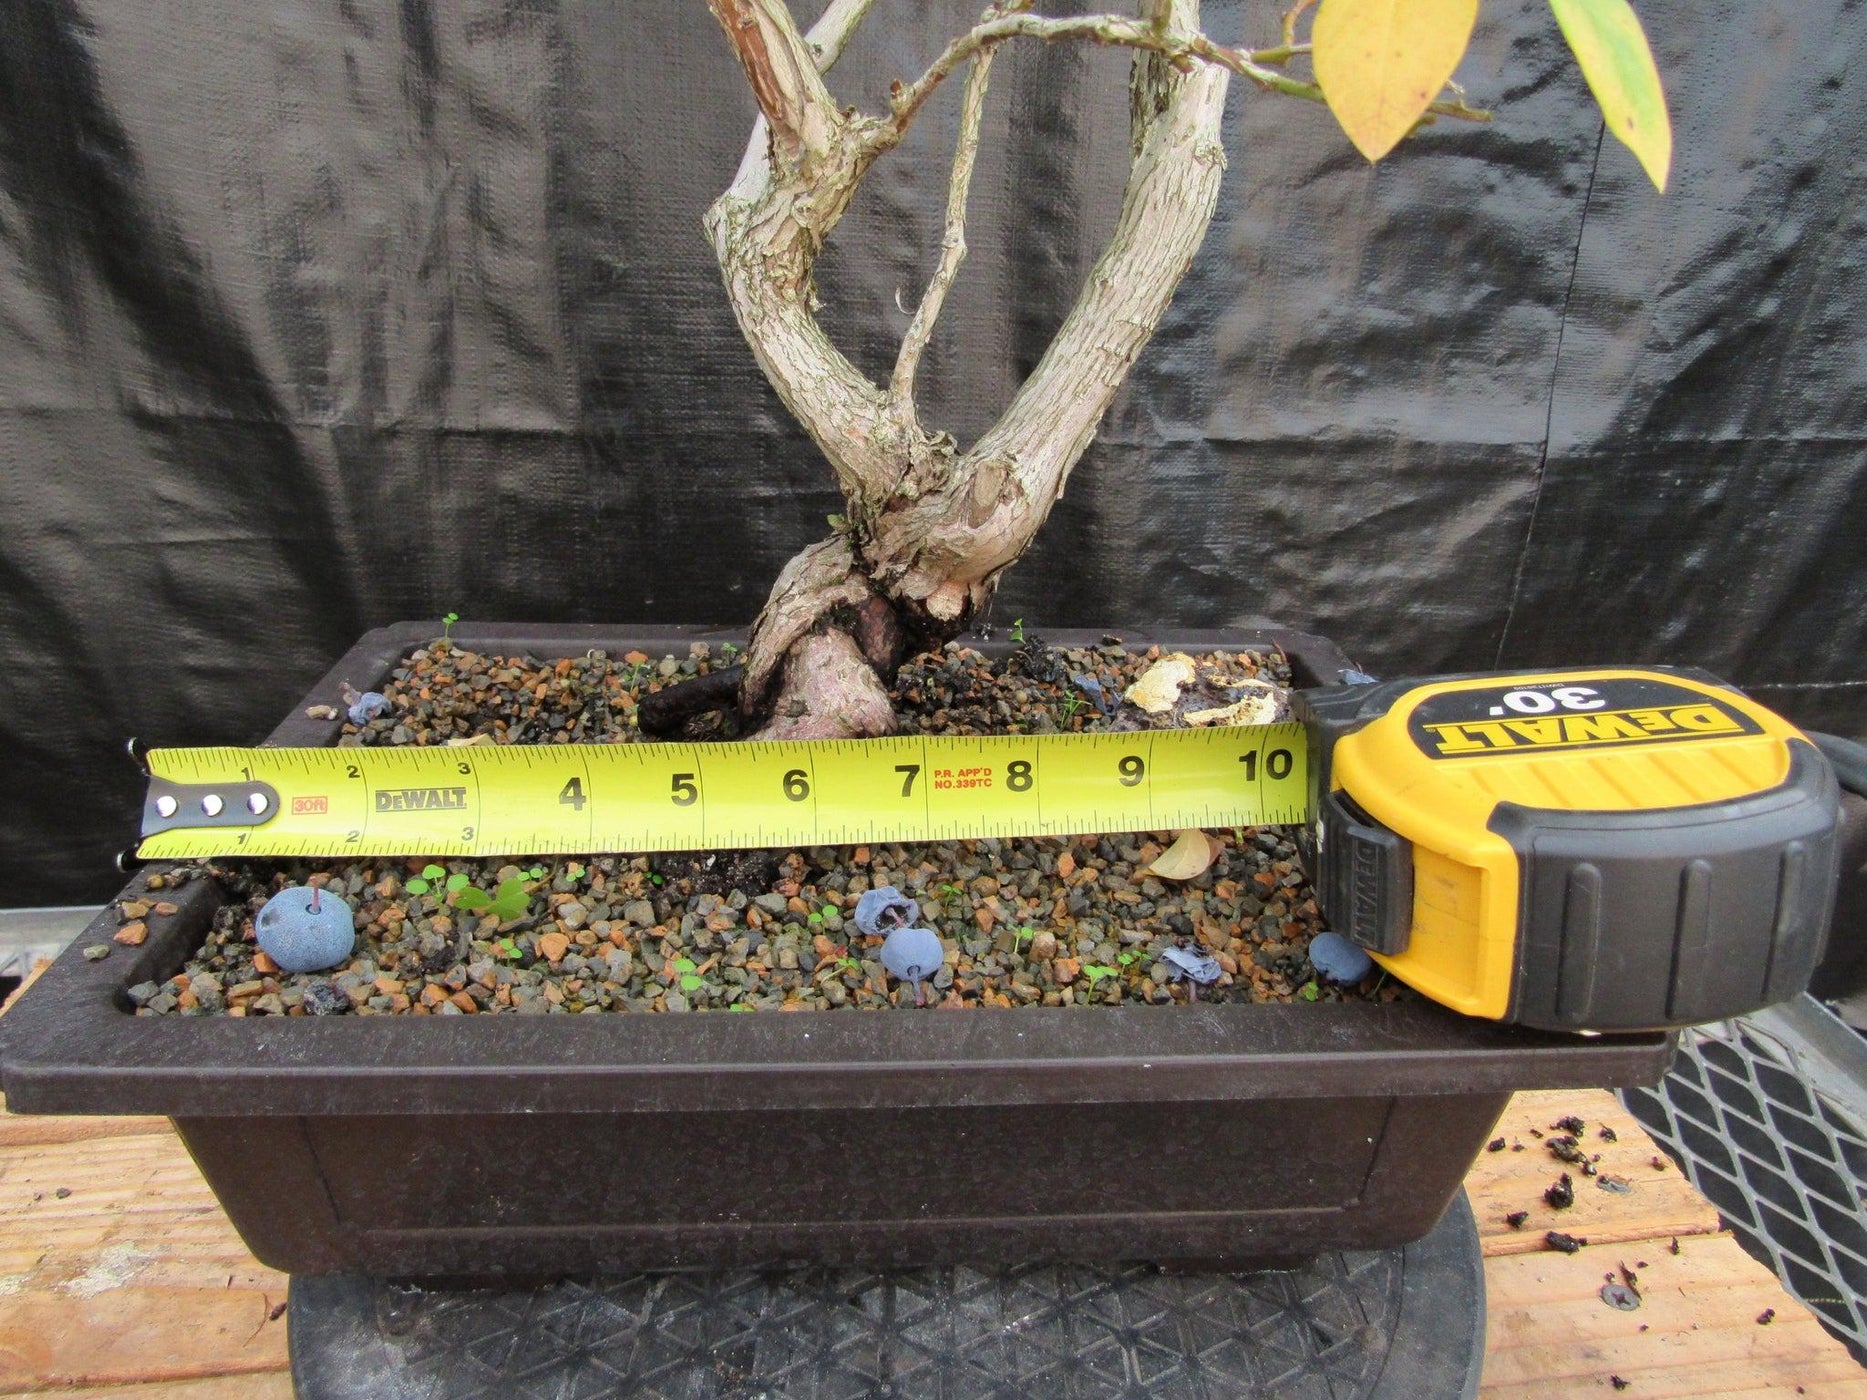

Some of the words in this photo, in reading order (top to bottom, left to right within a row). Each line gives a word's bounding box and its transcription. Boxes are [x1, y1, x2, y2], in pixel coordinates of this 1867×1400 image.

[346, 765, 361, 779] 2
[457, 762, 472, 775] 3
[1118, 755, 1146, 787] 9
[1239, 749, 1294, 781] 10
[934, 769, 955, 778] P.R.
[958, 767, 992, 777] APP'D
[1006, 760, 1034, 792] 8
[782, 769, 810, 802] 6
[894, 764, 920, 797] 7
[934, 778, 993, 789] NO.339TC
[558, 777, 587, 811] 4
[671, 773, 698, 806] 5
[294, 799, 326, 812] 30ft
[237, 833, 247, 845] 1
[345, 830, 361, 843] 2
[461, 827, 475, 841] 3
